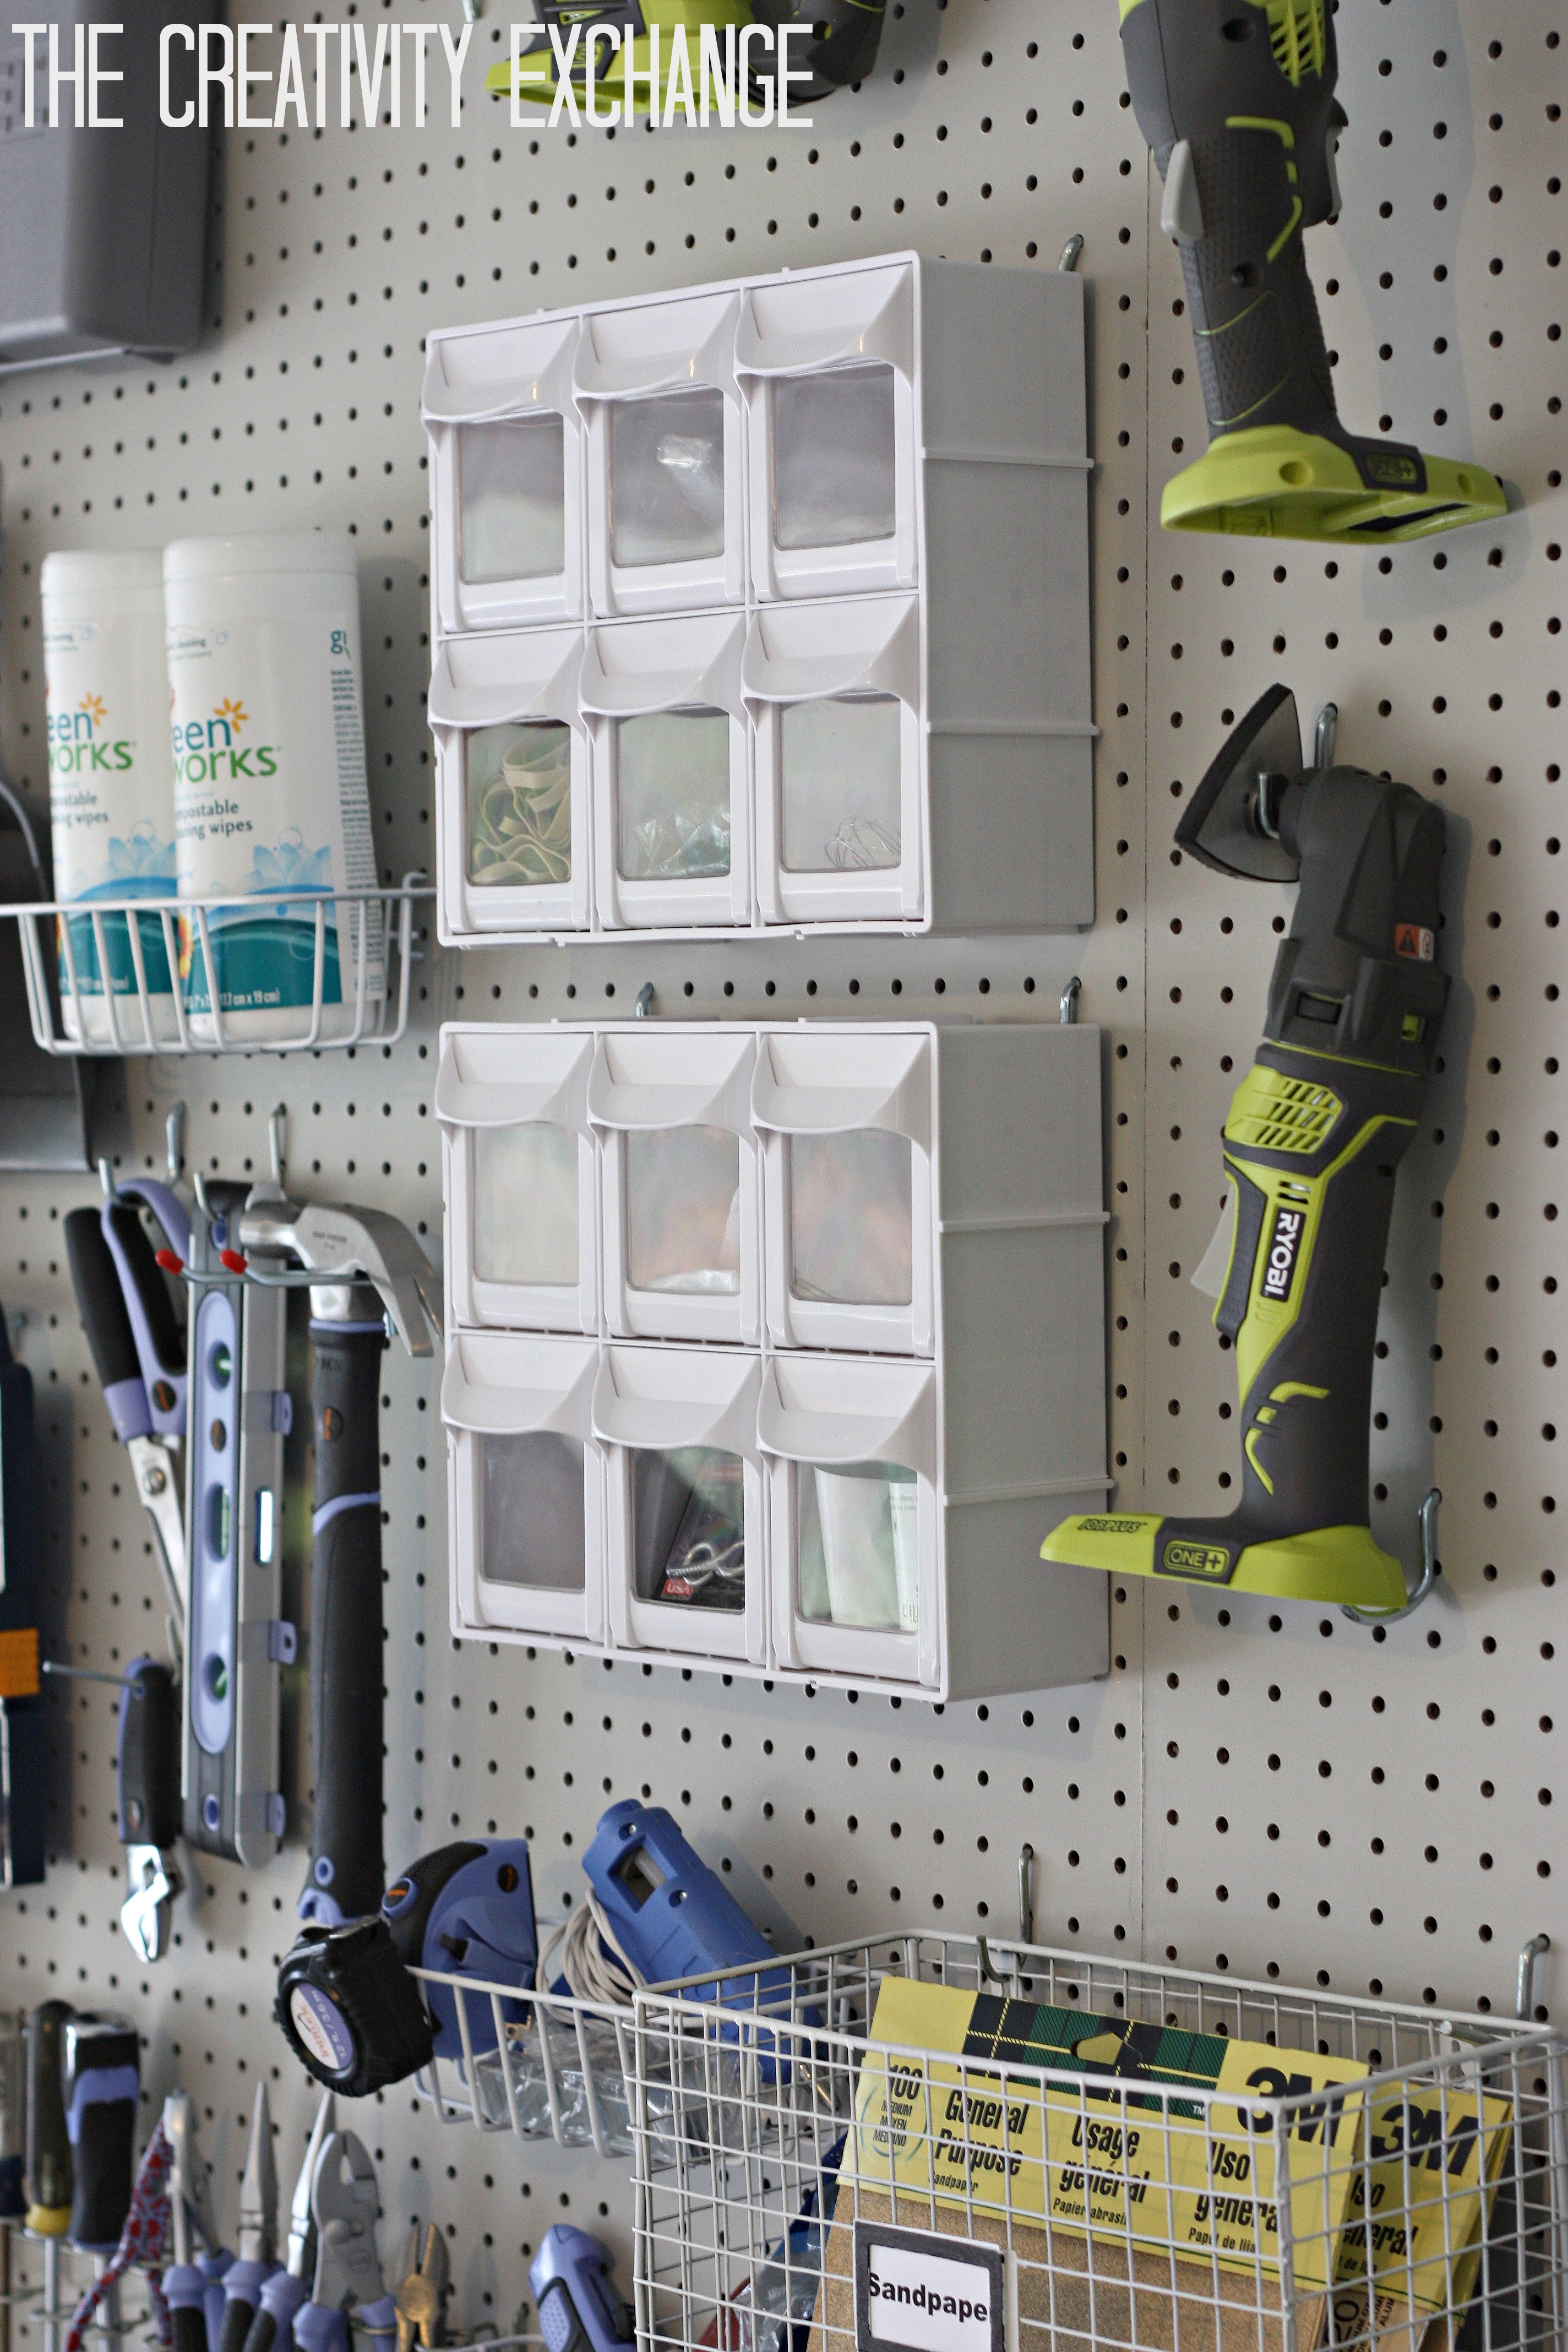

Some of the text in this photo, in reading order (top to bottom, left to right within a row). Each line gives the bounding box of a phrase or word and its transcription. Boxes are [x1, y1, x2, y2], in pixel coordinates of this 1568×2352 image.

[50, 741, 133, 772] orks
[209, 819, 253, 837] wipes
[1264, 1212, 1300, 1295] RYOBI
[889, 2064, 923, 2100] 100
[880, 2114, 907, 2131] MYEN
[881, 2099, 913, 2117] MDIUM
[945, 2089, 1030, 2135] General
[1236, 2067, 1345, 2148] 3M
[873, 2129, 907, 2147] MEDANO
[934, 2127, 1023, 2175] Purpose
[1071, 2115, 1140, 2160] Usage
[1370, 2104, 1480, 2177] 3M
[1206, 2141, 1251, 2181] Uso
[1053, 2197, 1085, 2214] Papier
[1194, 2193, 1278, 2233] genera
[1222, 2235, 1236, 2249] de
